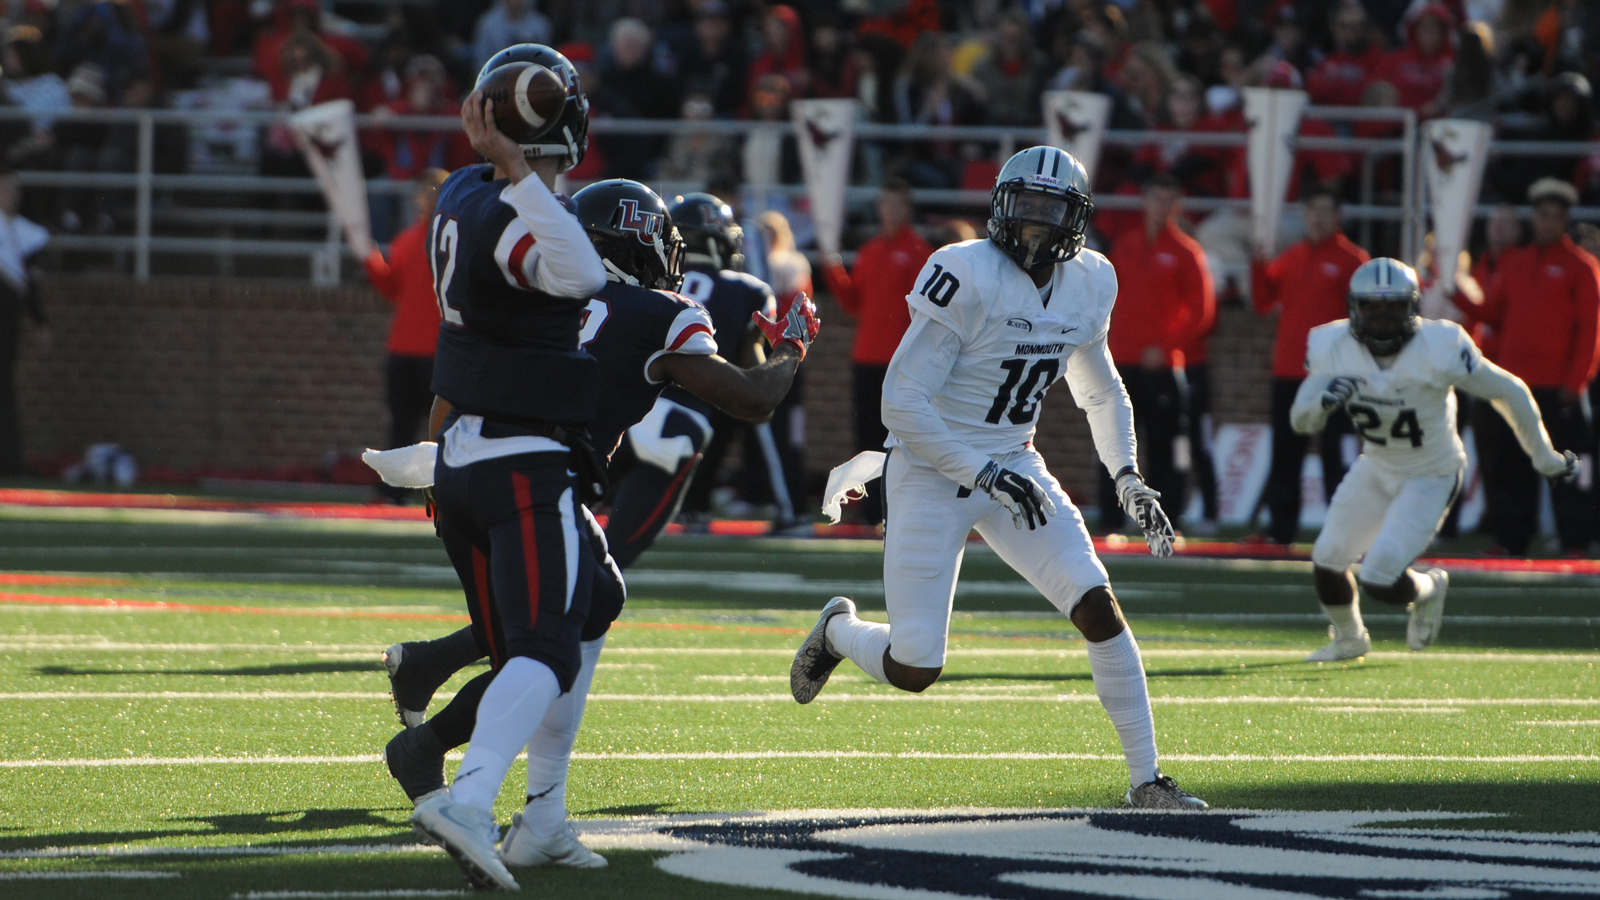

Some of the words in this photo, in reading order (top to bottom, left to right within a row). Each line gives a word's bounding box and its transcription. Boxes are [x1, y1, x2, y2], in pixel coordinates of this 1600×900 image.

[1036, 175, 1057, 185] Riddell
[620, 199, 665, 246] LU
[430, 213, 465, 326] 12
[919, 263, 960, 308] 10
[1015, 343, 1066, 355] MONMOUTH
[984, 357, 1060, 426] 10
[1349, 403, 1424, 448] 24
